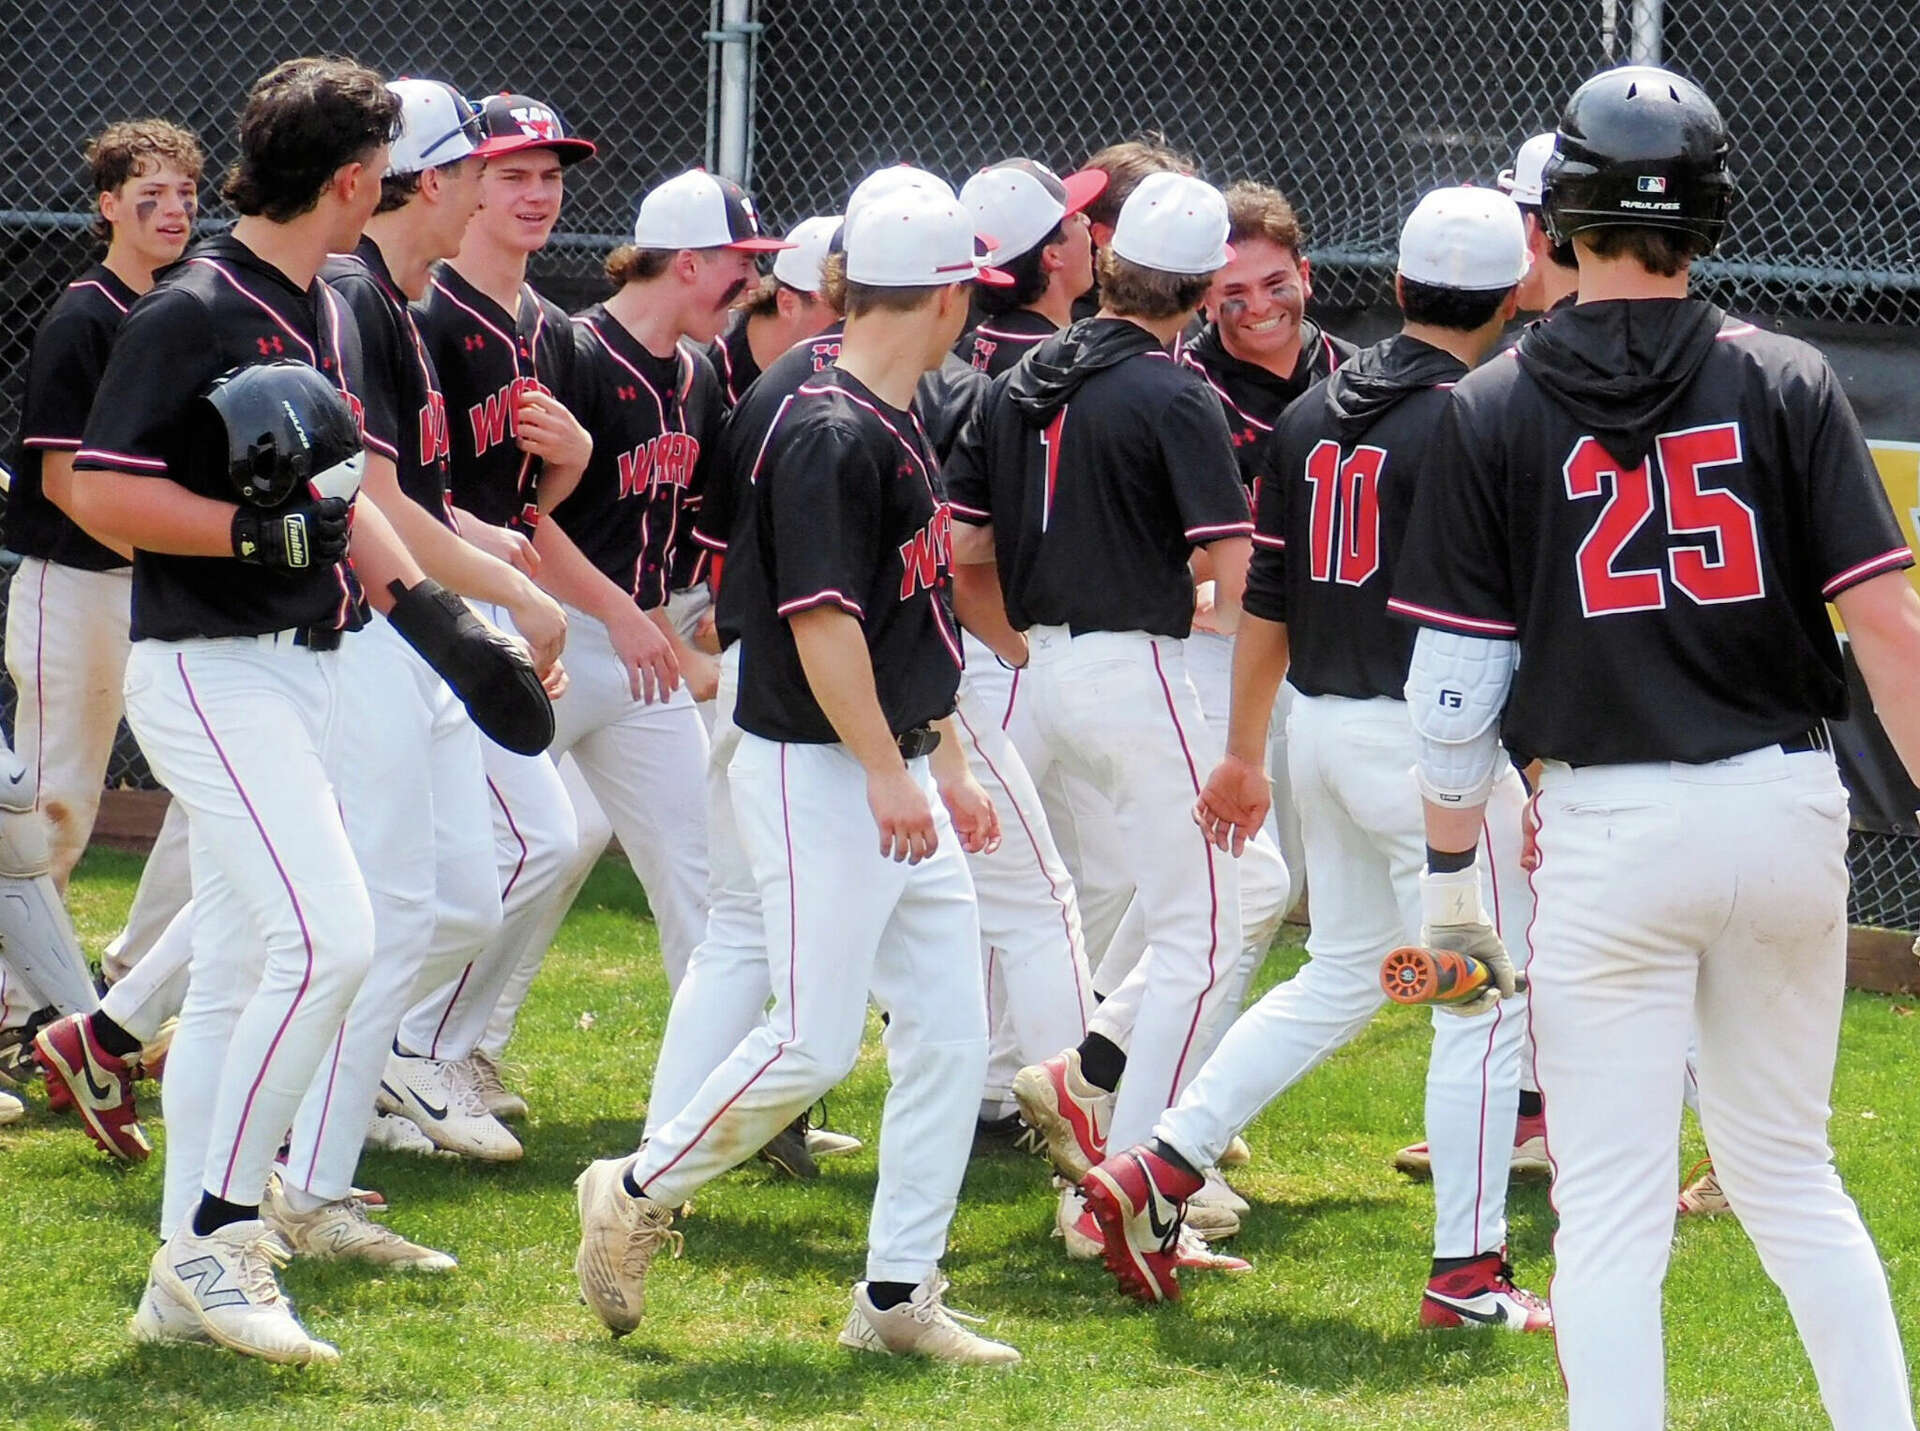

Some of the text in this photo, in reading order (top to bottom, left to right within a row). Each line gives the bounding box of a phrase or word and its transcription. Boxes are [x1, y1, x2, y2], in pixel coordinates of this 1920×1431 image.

[288, 518, 304, 566] Franklin
[1305, 438, 1388, 587] 10
[1563, 421, 1766, 619] 25
